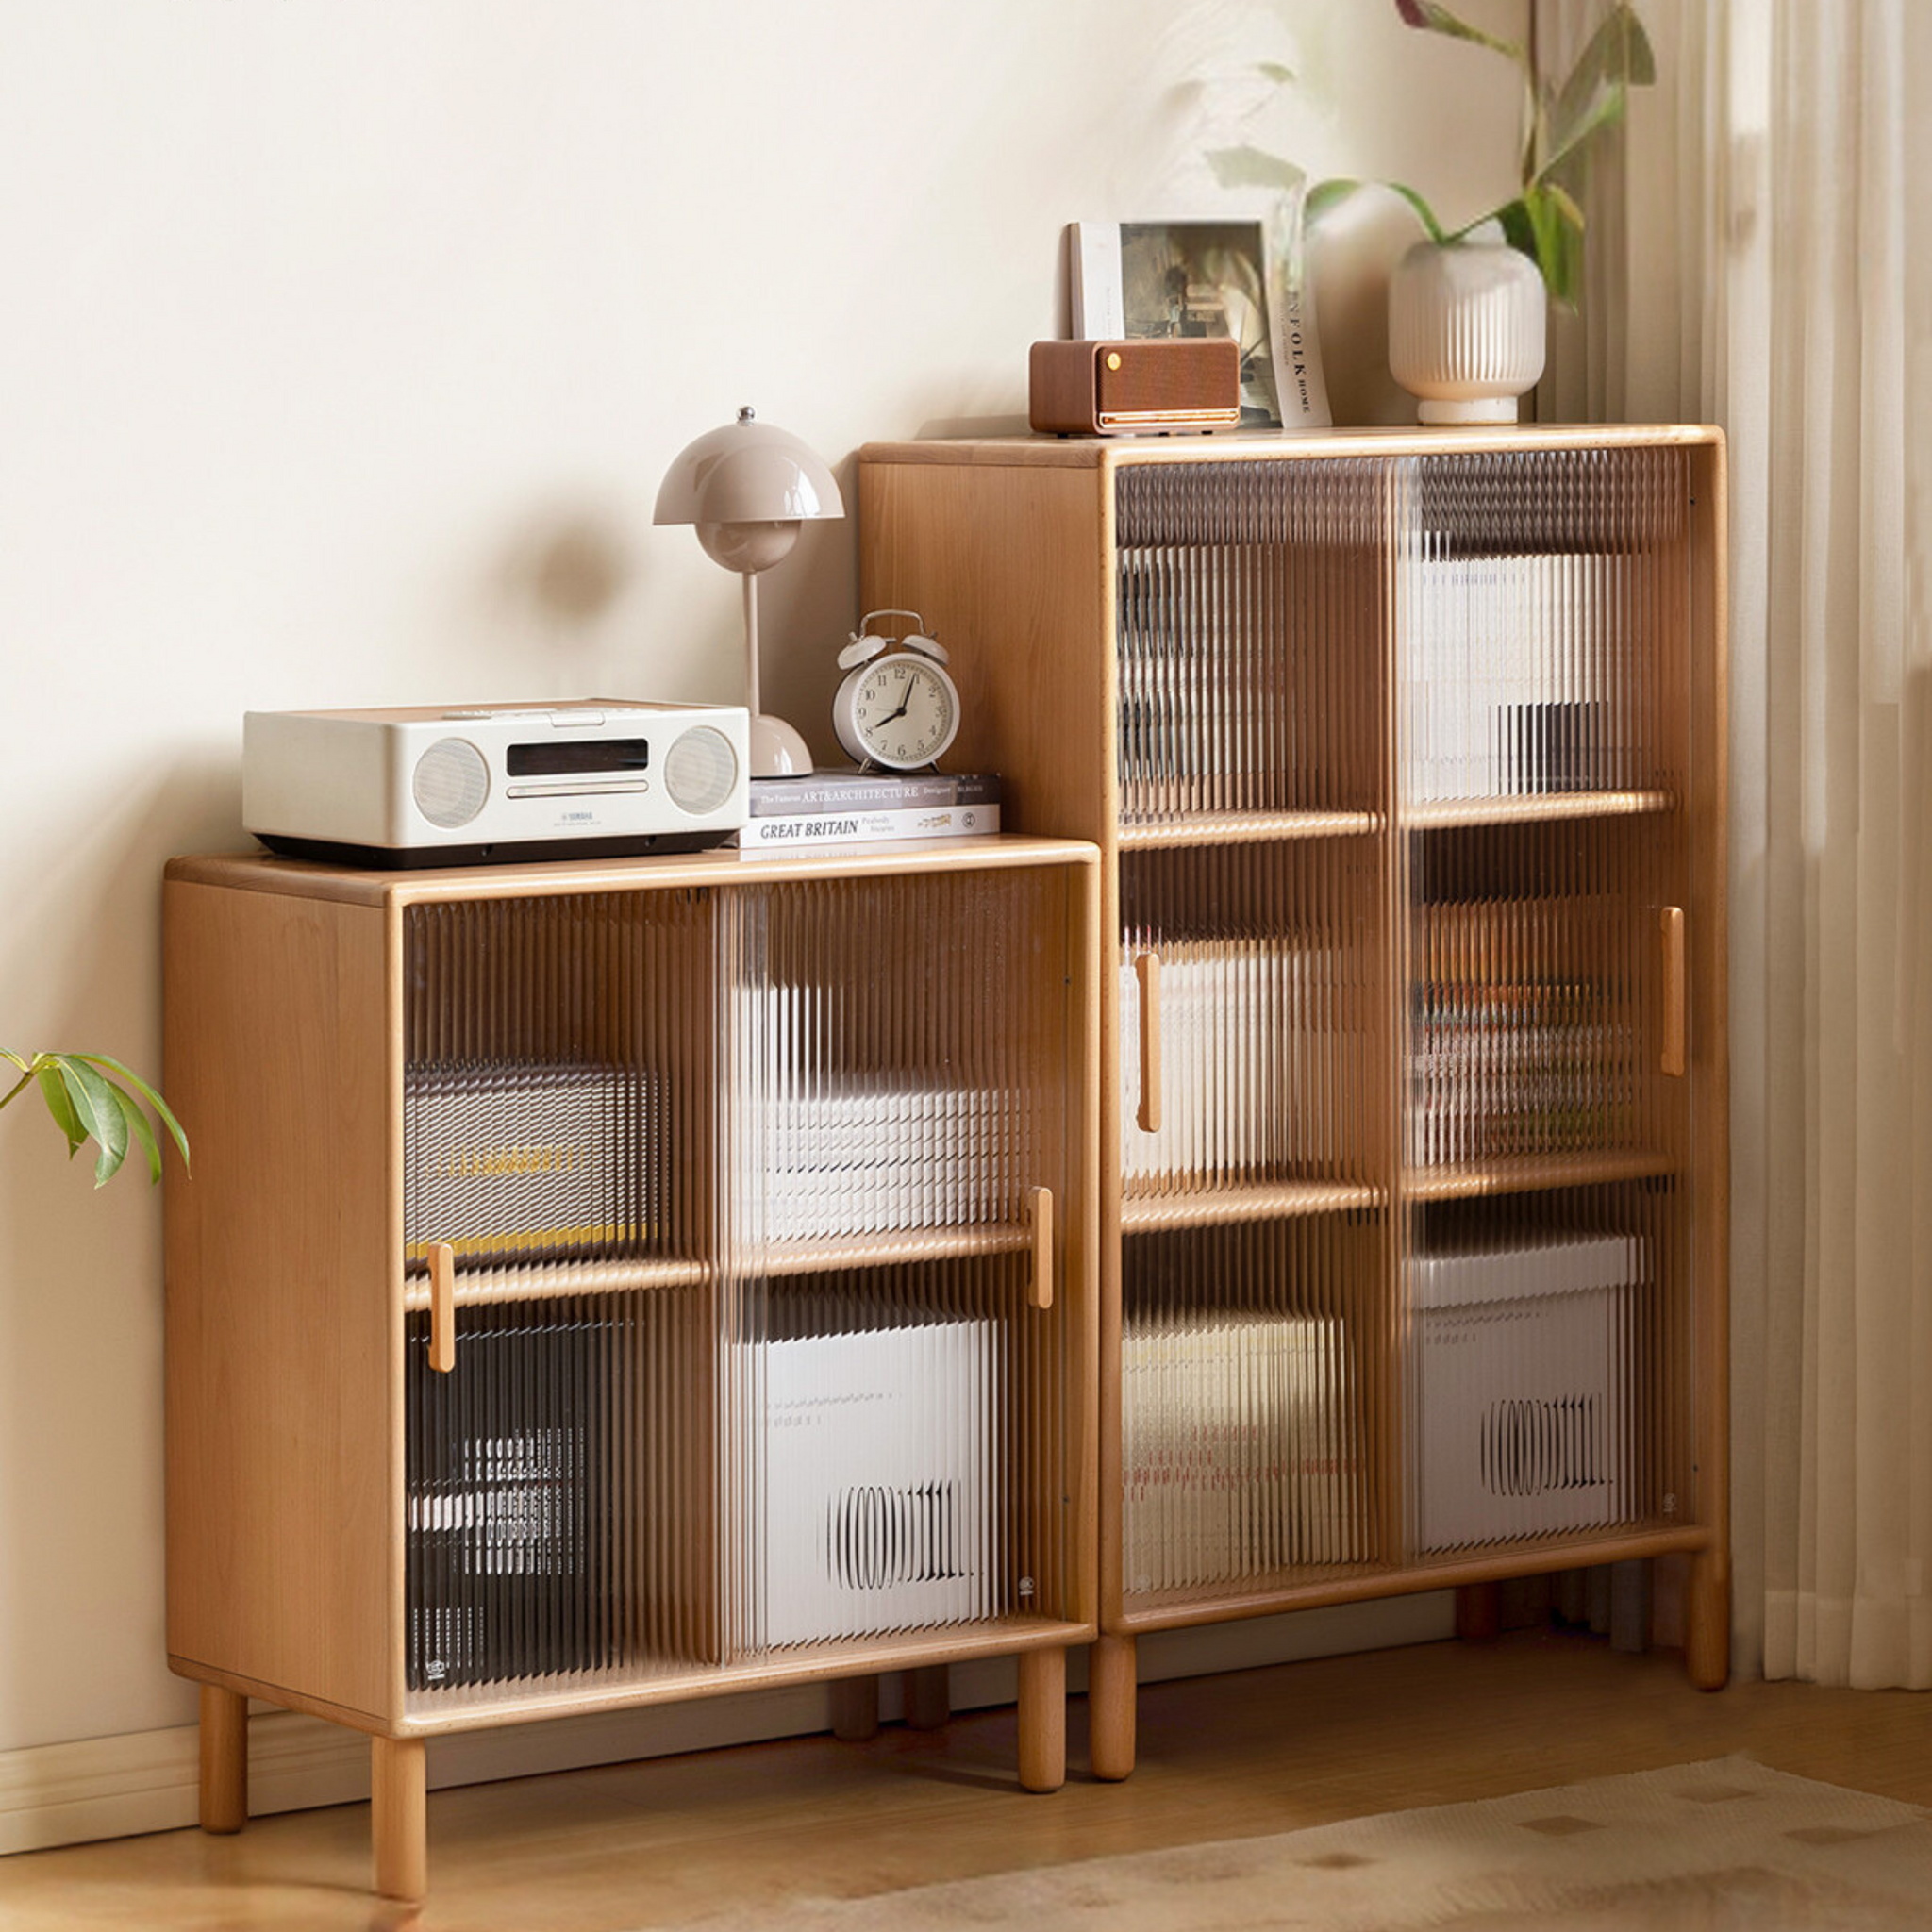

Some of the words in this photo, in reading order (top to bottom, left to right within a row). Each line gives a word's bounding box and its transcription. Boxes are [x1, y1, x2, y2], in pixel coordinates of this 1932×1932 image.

[1298, 379, 1311, 413] HOME
[894, 669, 906, 679] 12
[877, 675, 887, 686] 11
[865, 690, 875, 700] 10
[858, 708, 867, 718] 9
[865, 727, 874, 737] 8
[880, 740, 888, 751] 7
[897, 744, 906, 756] 6
[917, 740, 925, 750] 5
[760, 823, 803, 839] GREAT
[804, 819, 859, 837] BRITAIN
